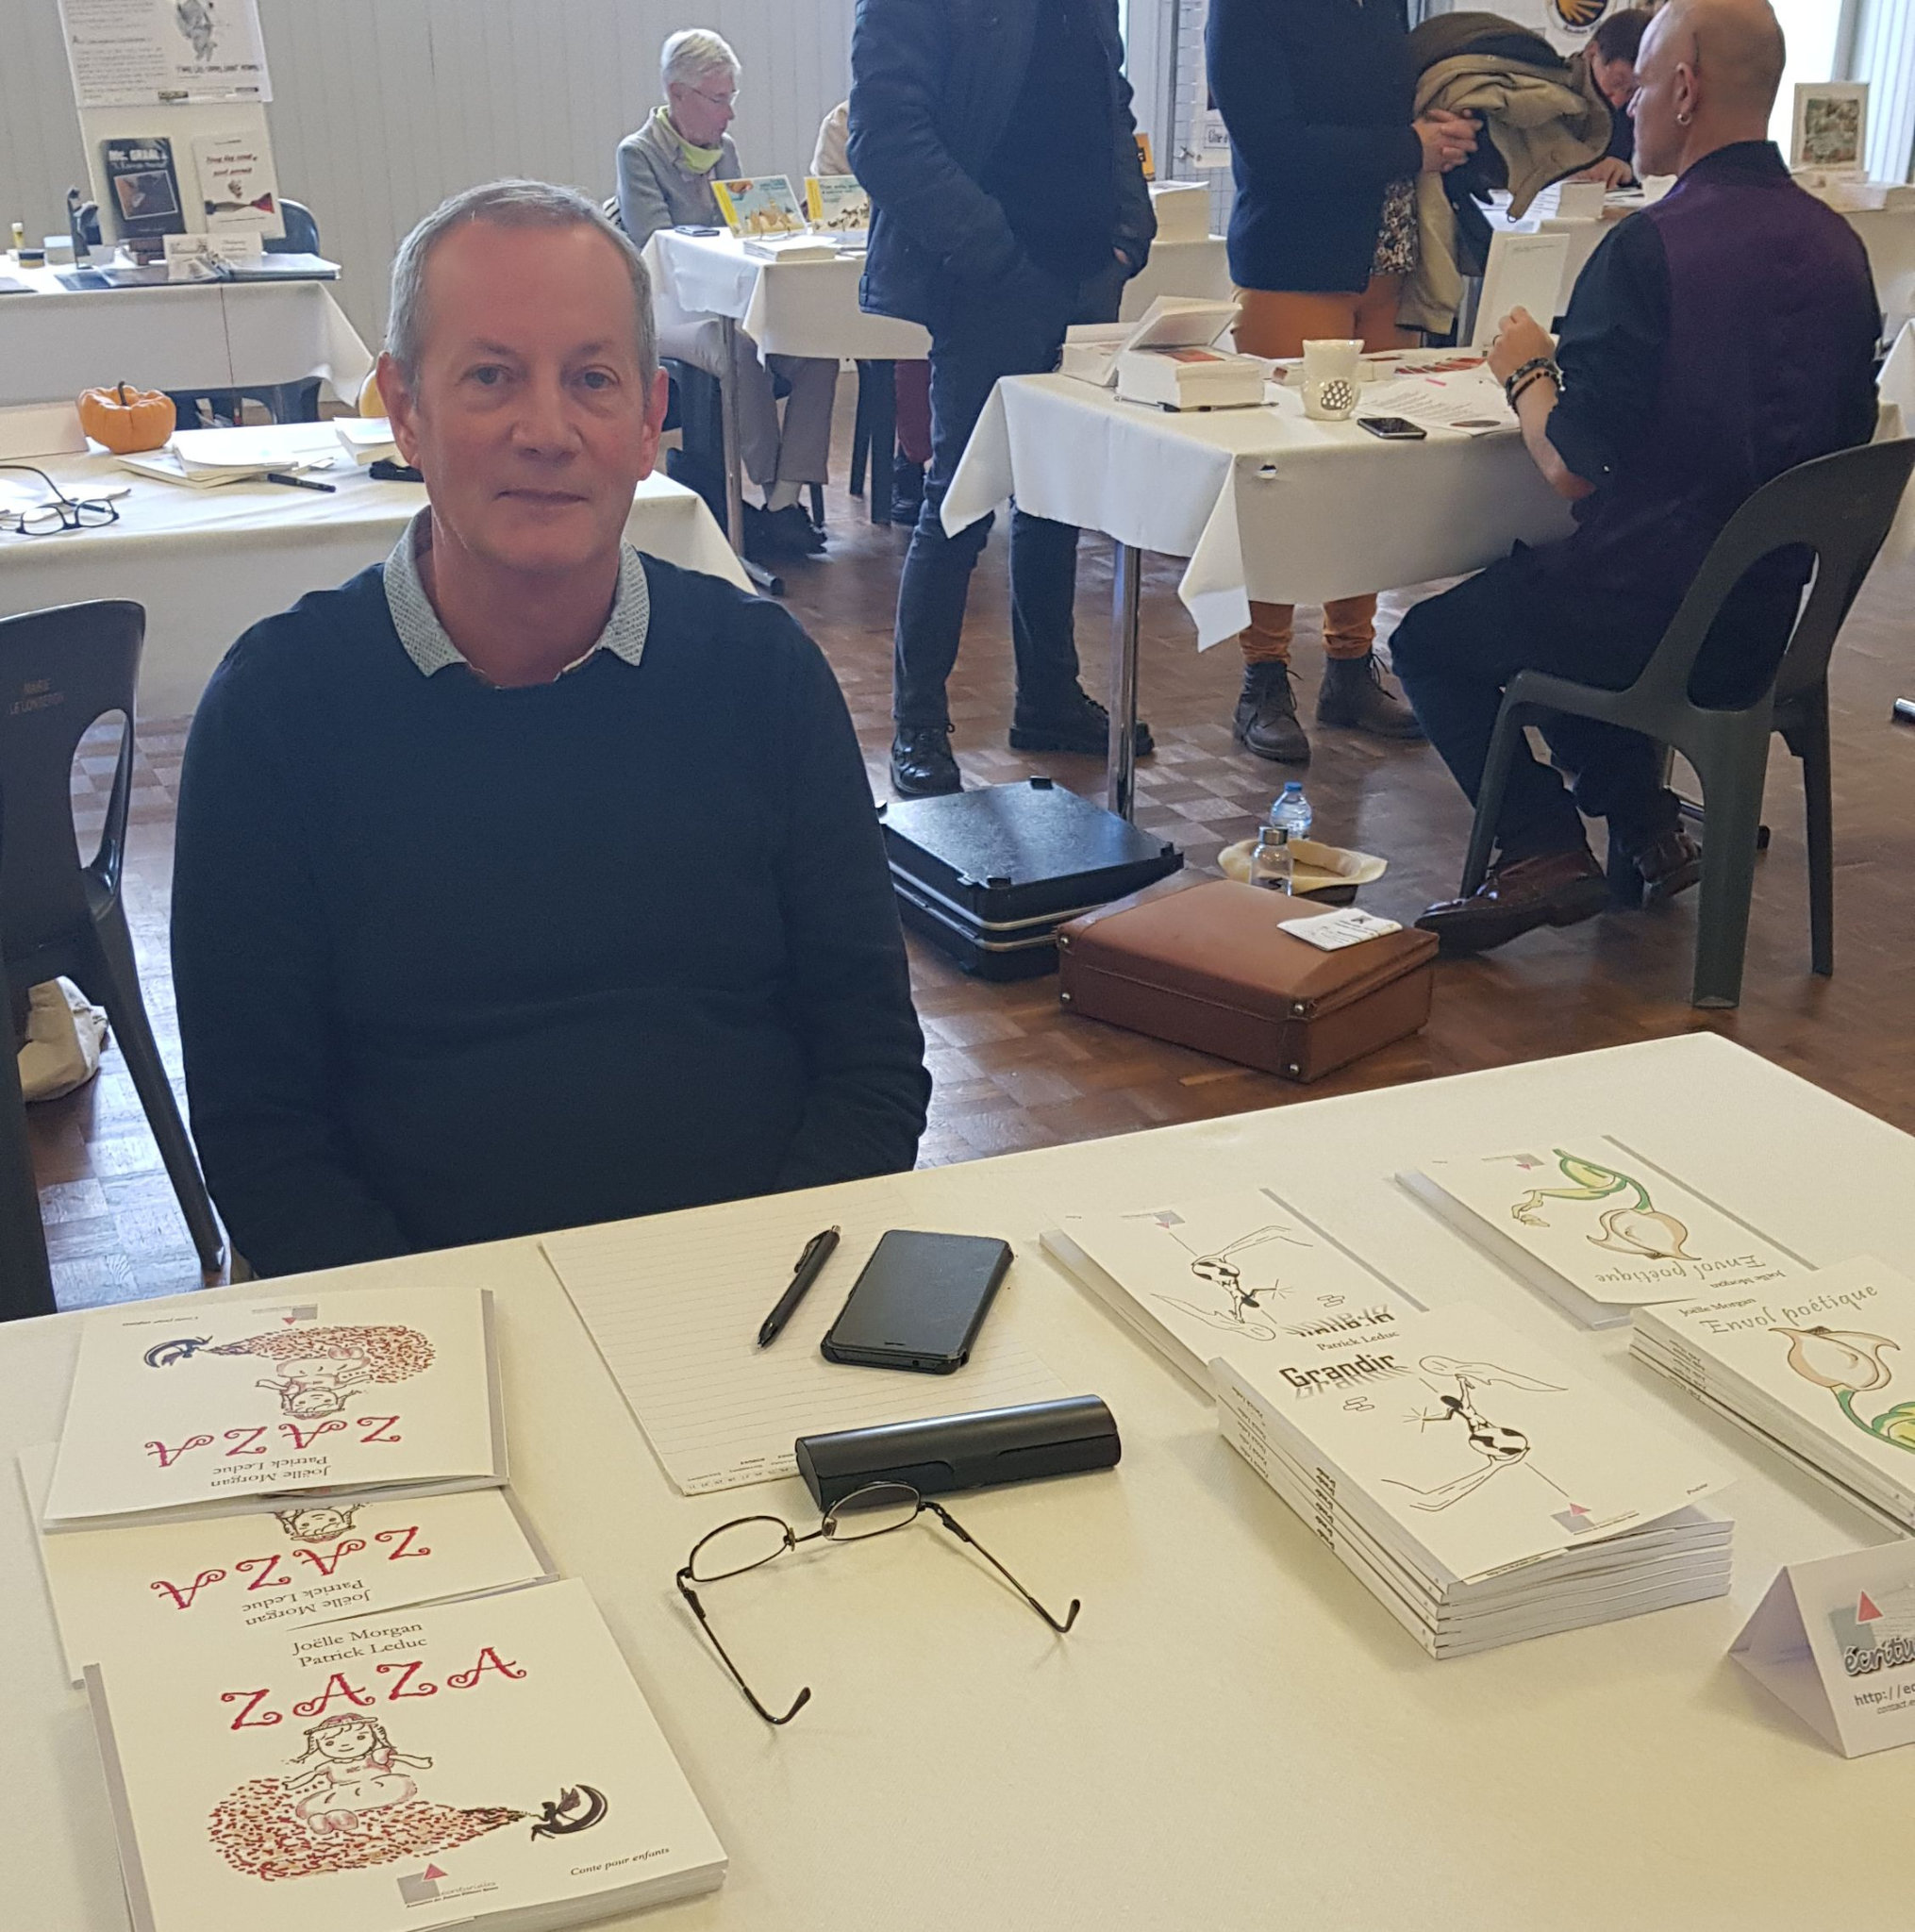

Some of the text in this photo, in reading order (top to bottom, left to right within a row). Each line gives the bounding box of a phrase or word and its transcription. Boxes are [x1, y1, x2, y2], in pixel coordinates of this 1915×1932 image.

[1693, 1255, 1766, 1281] Envol
[1699, 1286, 1878, 1333] Envol poétique
[1317, 1330, 1400, 1351] Patrick Leduc
[1278, 1354, 1395, 1388] Grandir
[144, 1415, 402, 1467] ZAZA
[210, 1472, 276, 1487] Morgan
[213, 1456, 328, 1474] Patrick Leduc
[151, 1526, 431, 1609] ZAZA
[241, 1579, 363, 1612] Patrick Leduc
[246, 1590, 371, 1626] Joëlle Morgan
[292, 1624, 423, 1656] Joëlle Morgan
[299, 1637, 427, 1667] Patrick Leduc
[220, 1647, 526, 1730] ZAZA
[570, 1847, 670, 1876] Conte pour enfants
